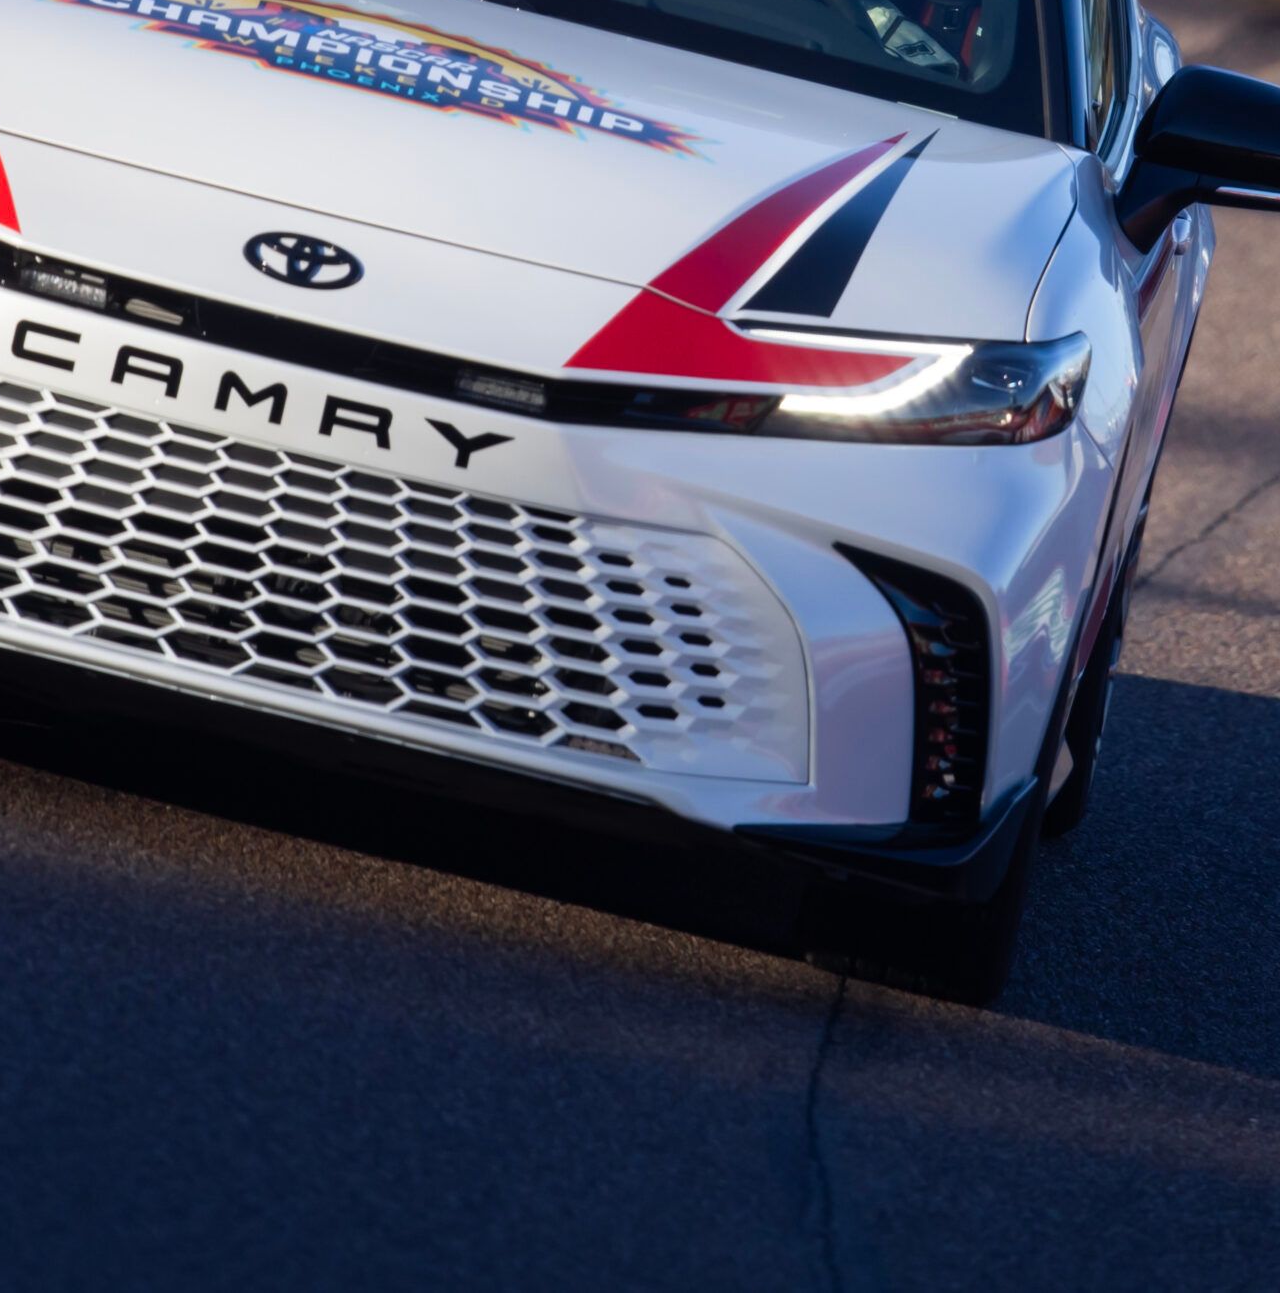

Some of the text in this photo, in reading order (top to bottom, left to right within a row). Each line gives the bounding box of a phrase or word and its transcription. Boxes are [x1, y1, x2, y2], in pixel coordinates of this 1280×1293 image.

[222, 32, 505, 109] WEEKEND
[275, 55, 440, 103] PHOENIX
[316, 28, 478, 73] NASCAR
[11, 319, 517, 470] CAMRY
